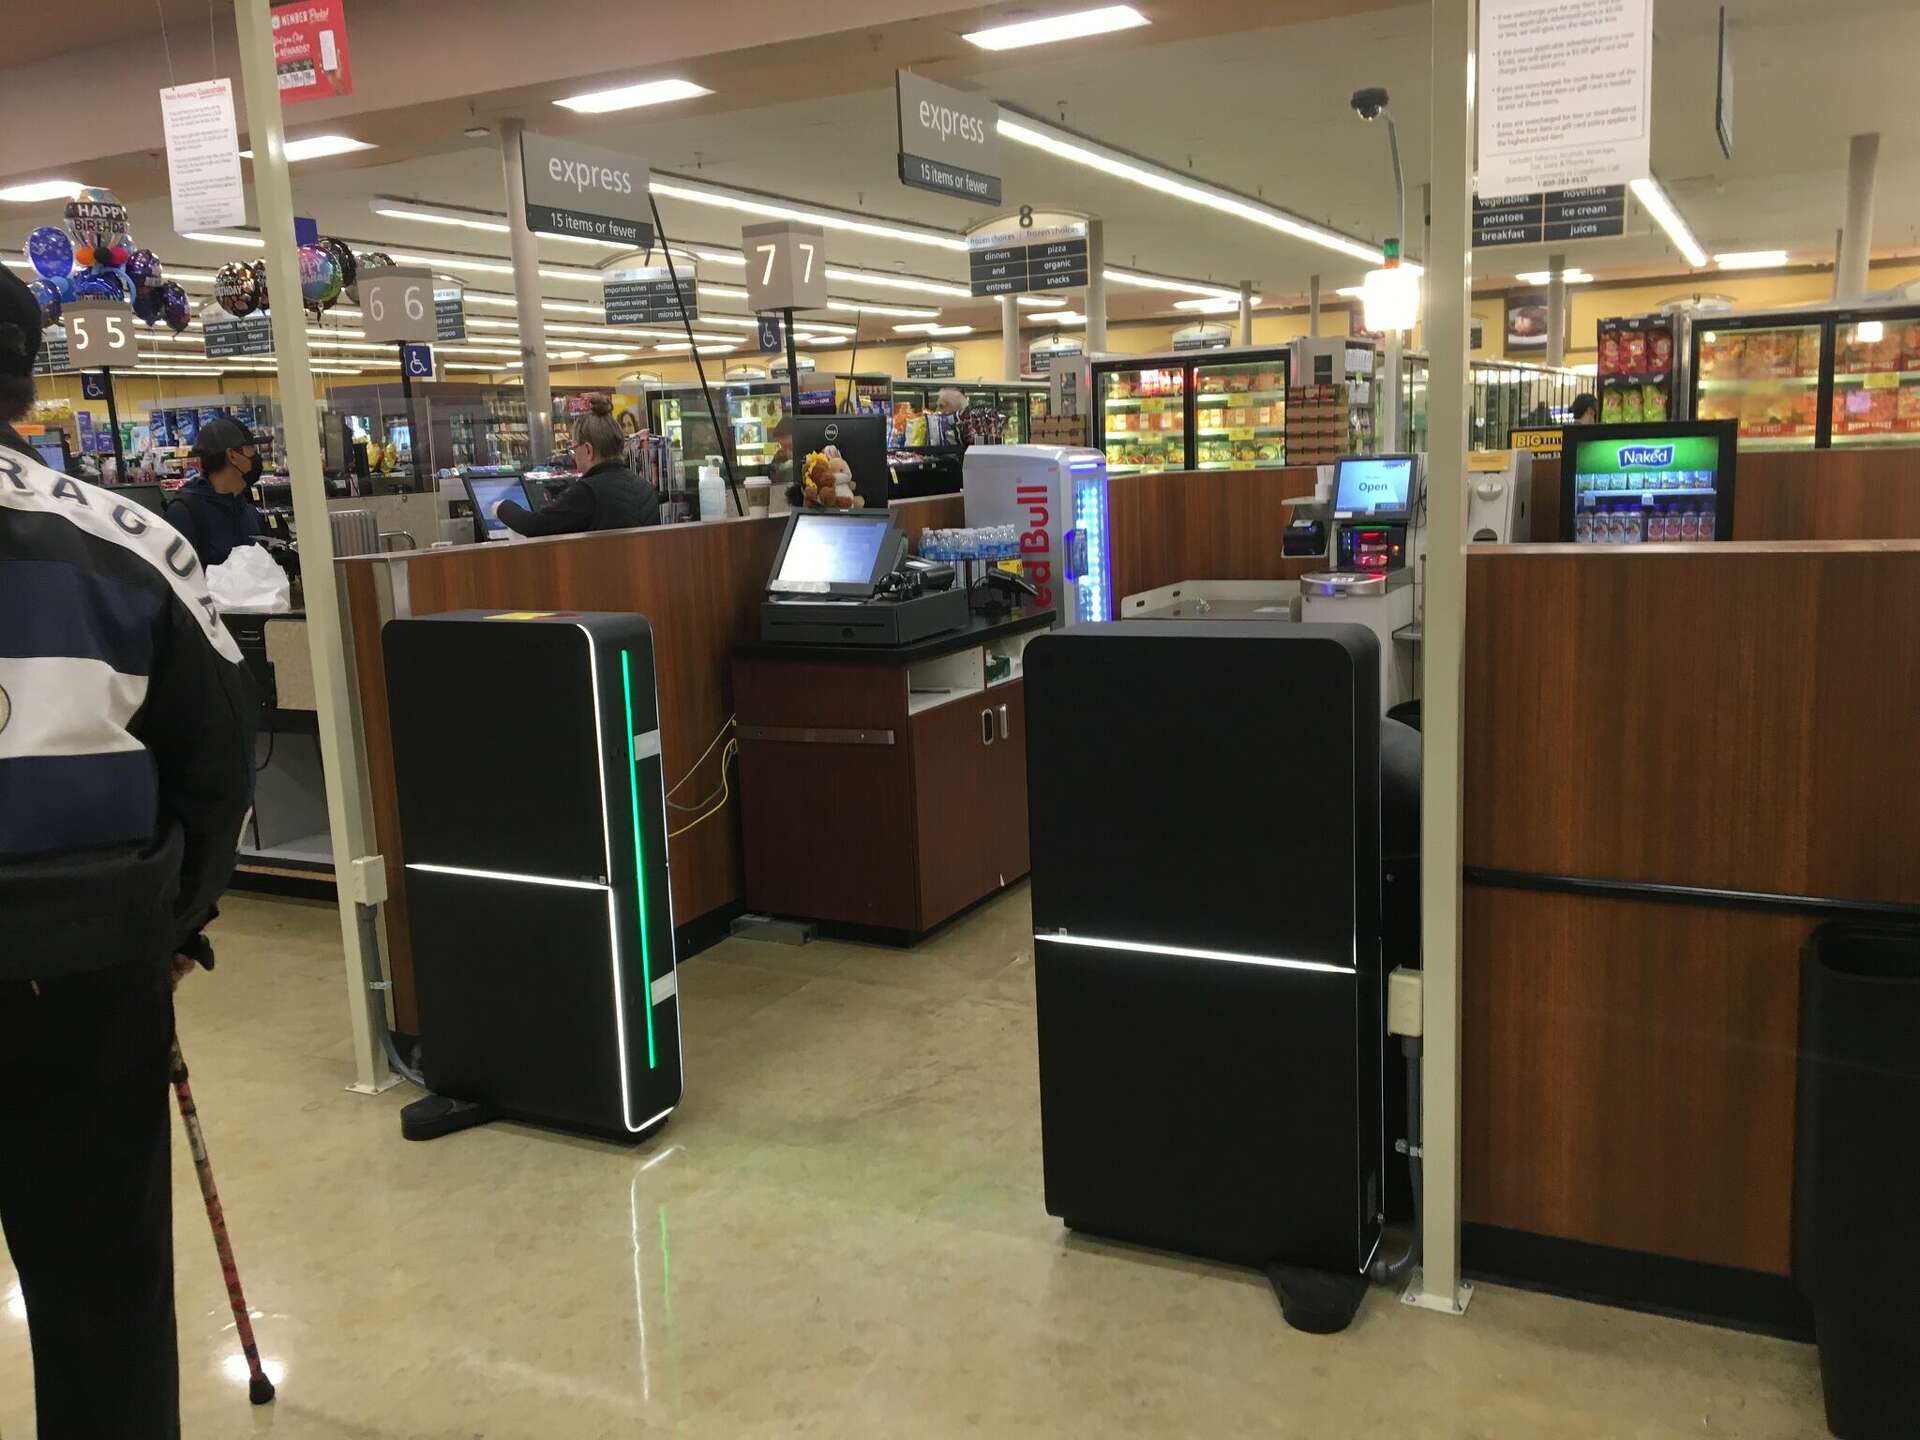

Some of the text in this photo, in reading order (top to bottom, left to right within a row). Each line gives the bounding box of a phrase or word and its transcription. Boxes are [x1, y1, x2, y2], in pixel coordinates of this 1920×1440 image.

[920, 100, 984, 144] express
[548, 157, 631, 194] express
[920, 163, 988, 194] 15 items or fewer
[78, 203, 126, 220] HAPPY
[1019, 204, 1033, 228] 8
[1577, 204, 1607, 217] cream
[551, 212, 637, 239] 15 items or fewer
[1483, 212, 1524, 227] potatoes
[1481, 228, 1525, 241] breakfast
[1570, 224, 1598, 236] juices
[985, 251, 1011, 261] dinners
[1047, 245, 1067, 255] pizza
[756, 243, 776, 285] 7
[800, 242, 813, 283] 7
[992, 266, 1006, 275] and
[1044, 259, 1071, 271] organic
[986, 281, 1012, 292] entrees
[1047, 274, 1070, 285] snacks
[370, 286, 384, 320] 6
[404, 286, 423, 320] 6
[611, 311, 644, 321] champagne
[73, 318, 89, 350] 5
[105, 317, 125, 348] 5
[1517, 435, 1541, 447] BIG
[1623, 447, 1668, 464] Naked
[1358, 482, 1388, 494] Open
[1016, 485, 1052, 609] ed Bull
